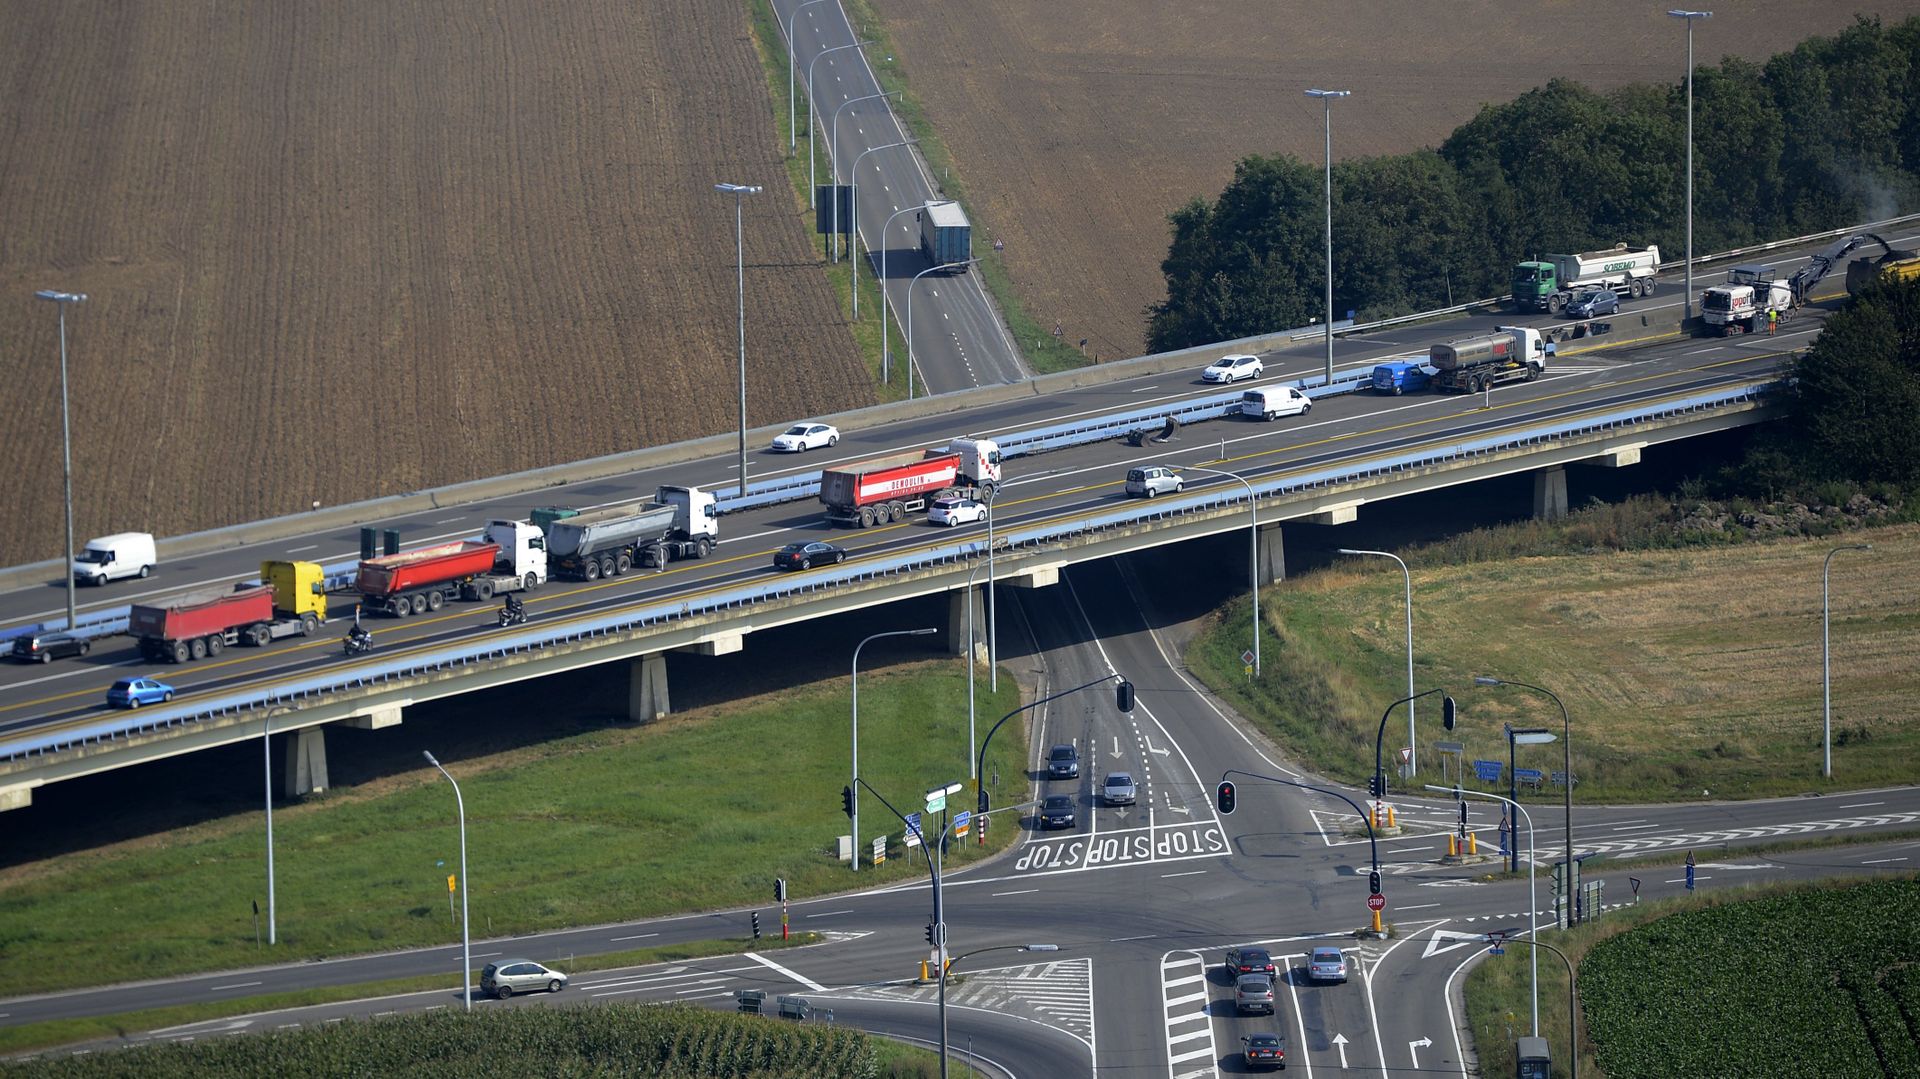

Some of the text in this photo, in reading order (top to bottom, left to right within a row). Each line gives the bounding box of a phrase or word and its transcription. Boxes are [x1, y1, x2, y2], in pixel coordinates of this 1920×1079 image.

[1602, 260, 1636, 273] SOBEMO
[891, 475, 925, 490] DEMOULIN
[1088, 836, 1149, 863] STOP
[1157, 828, 1223, 856] STOP
[1015, 842, 1083, 871] STOP
[1369, 898, 1384, 906] STOP
